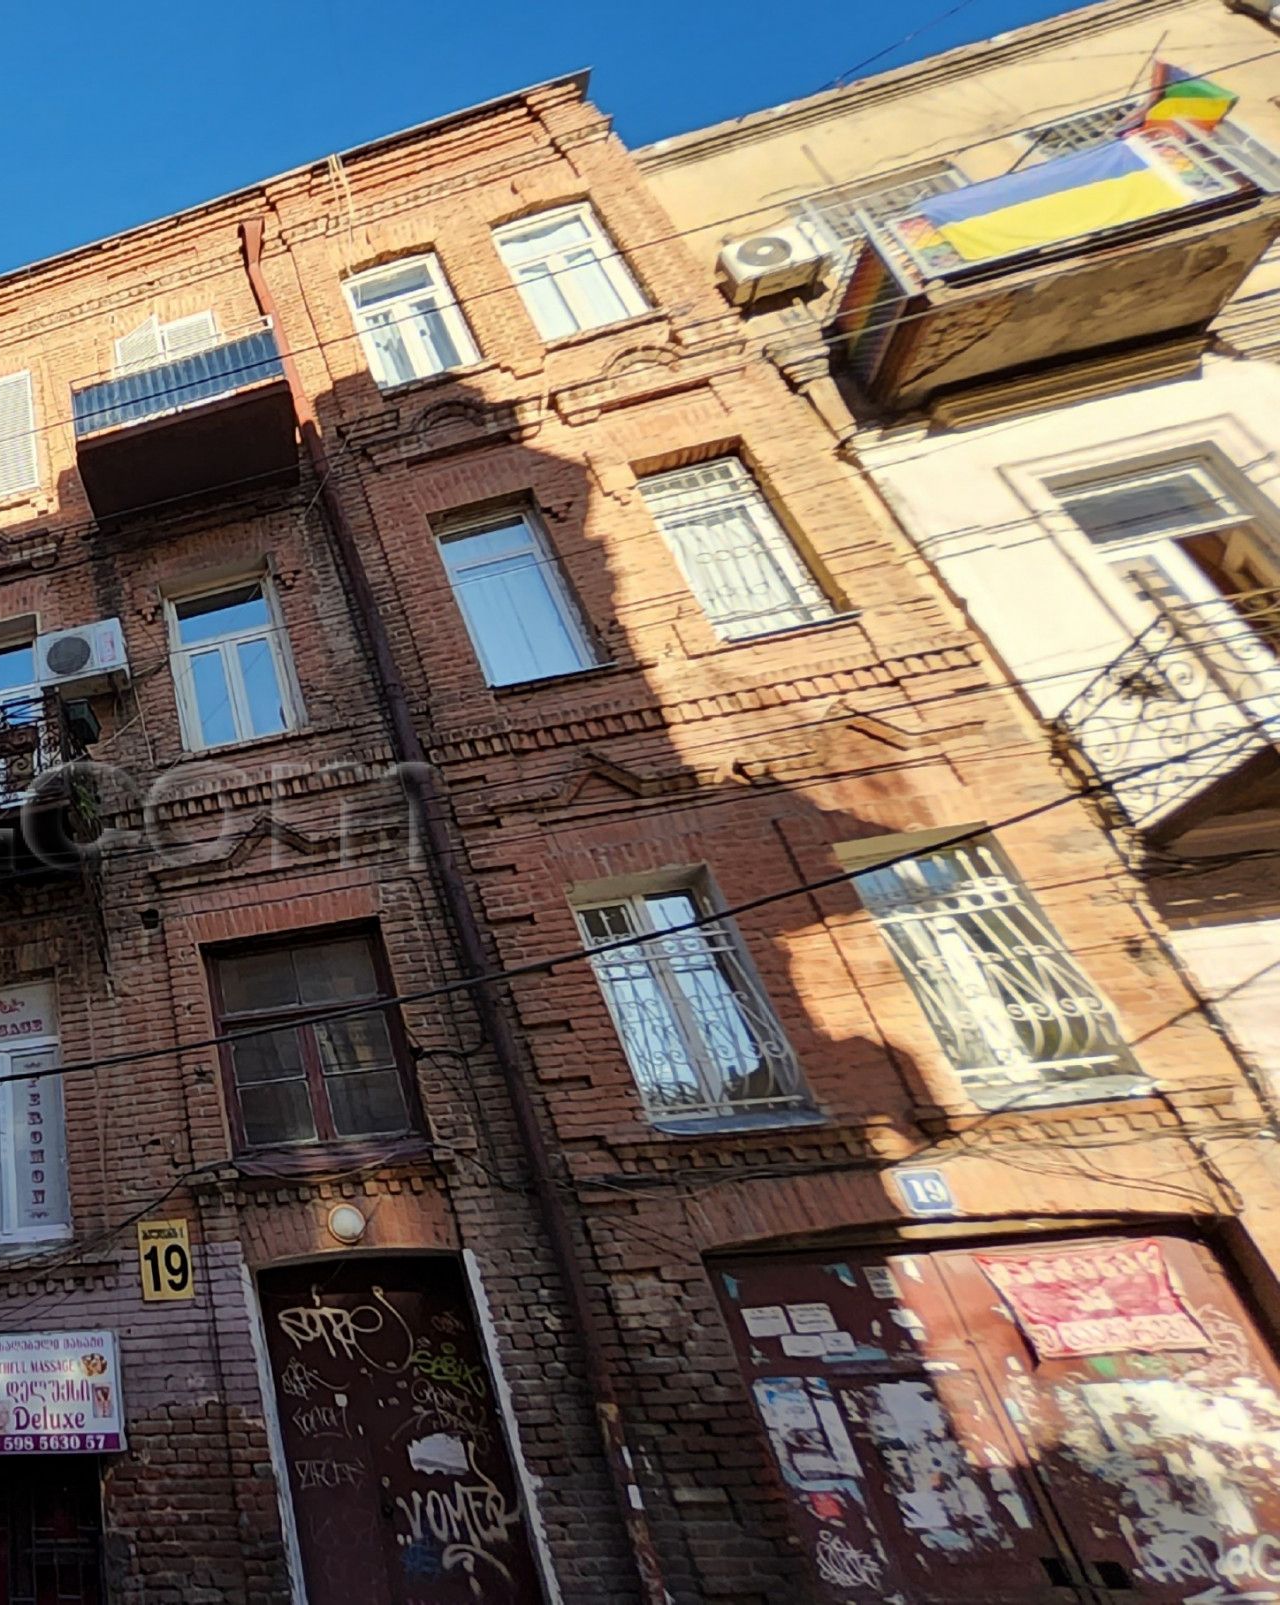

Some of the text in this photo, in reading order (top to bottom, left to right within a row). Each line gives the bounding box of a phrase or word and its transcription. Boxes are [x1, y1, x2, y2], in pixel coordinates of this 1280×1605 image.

[908, 1178, 949, 1203] 19
[143, 1243, 189, 1292] 19
[30, 1359, 74, 1374] MASSAGE
[14, 1405, 86, 1431] Deluxe
[4, 1434, 106, 1451] 598 5630 57
